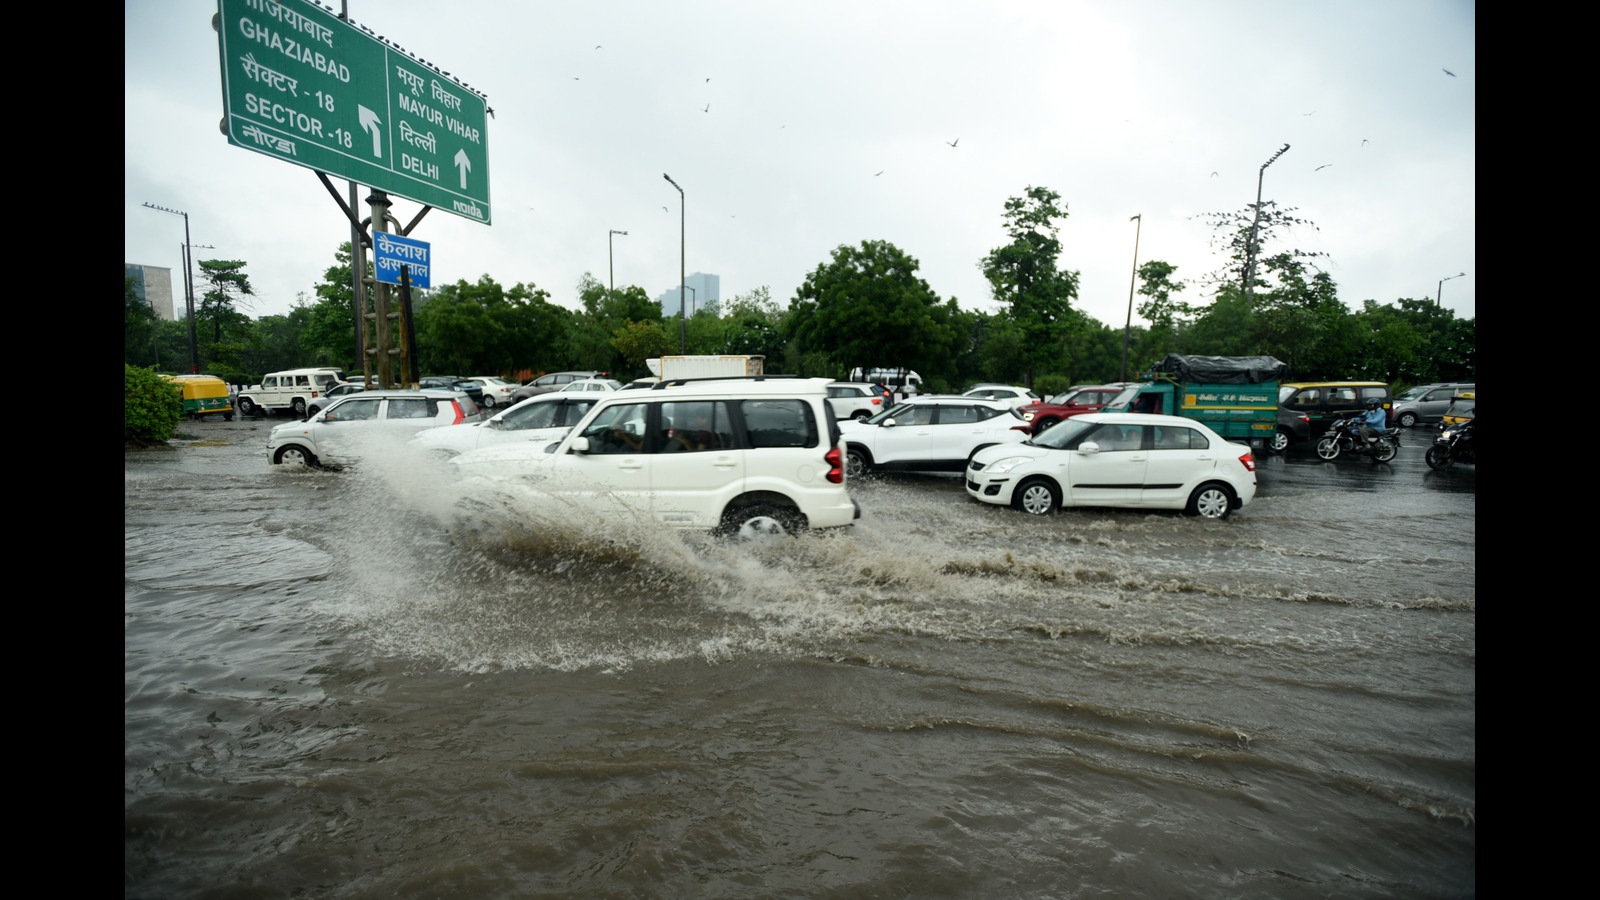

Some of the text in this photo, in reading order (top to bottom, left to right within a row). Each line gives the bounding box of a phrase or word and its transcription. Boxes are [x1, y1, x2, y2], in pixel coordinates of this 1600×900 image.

[239, 17, 350, 83] GHAZIABAD
[240, 52, 298, 97] सैक्टर
[315, 91, 335, 113] 18
[396, 65, 462, 112] मयूर विहार
[245, 93, 324, 139] SECTOR
[399, 93, 480, 144] MAYUR VIHAR
[399, 120, 437, 154] दिल्ली
[402, 153, 439, 180] DELHI
[378, 235, 427, 262] कैलाश
